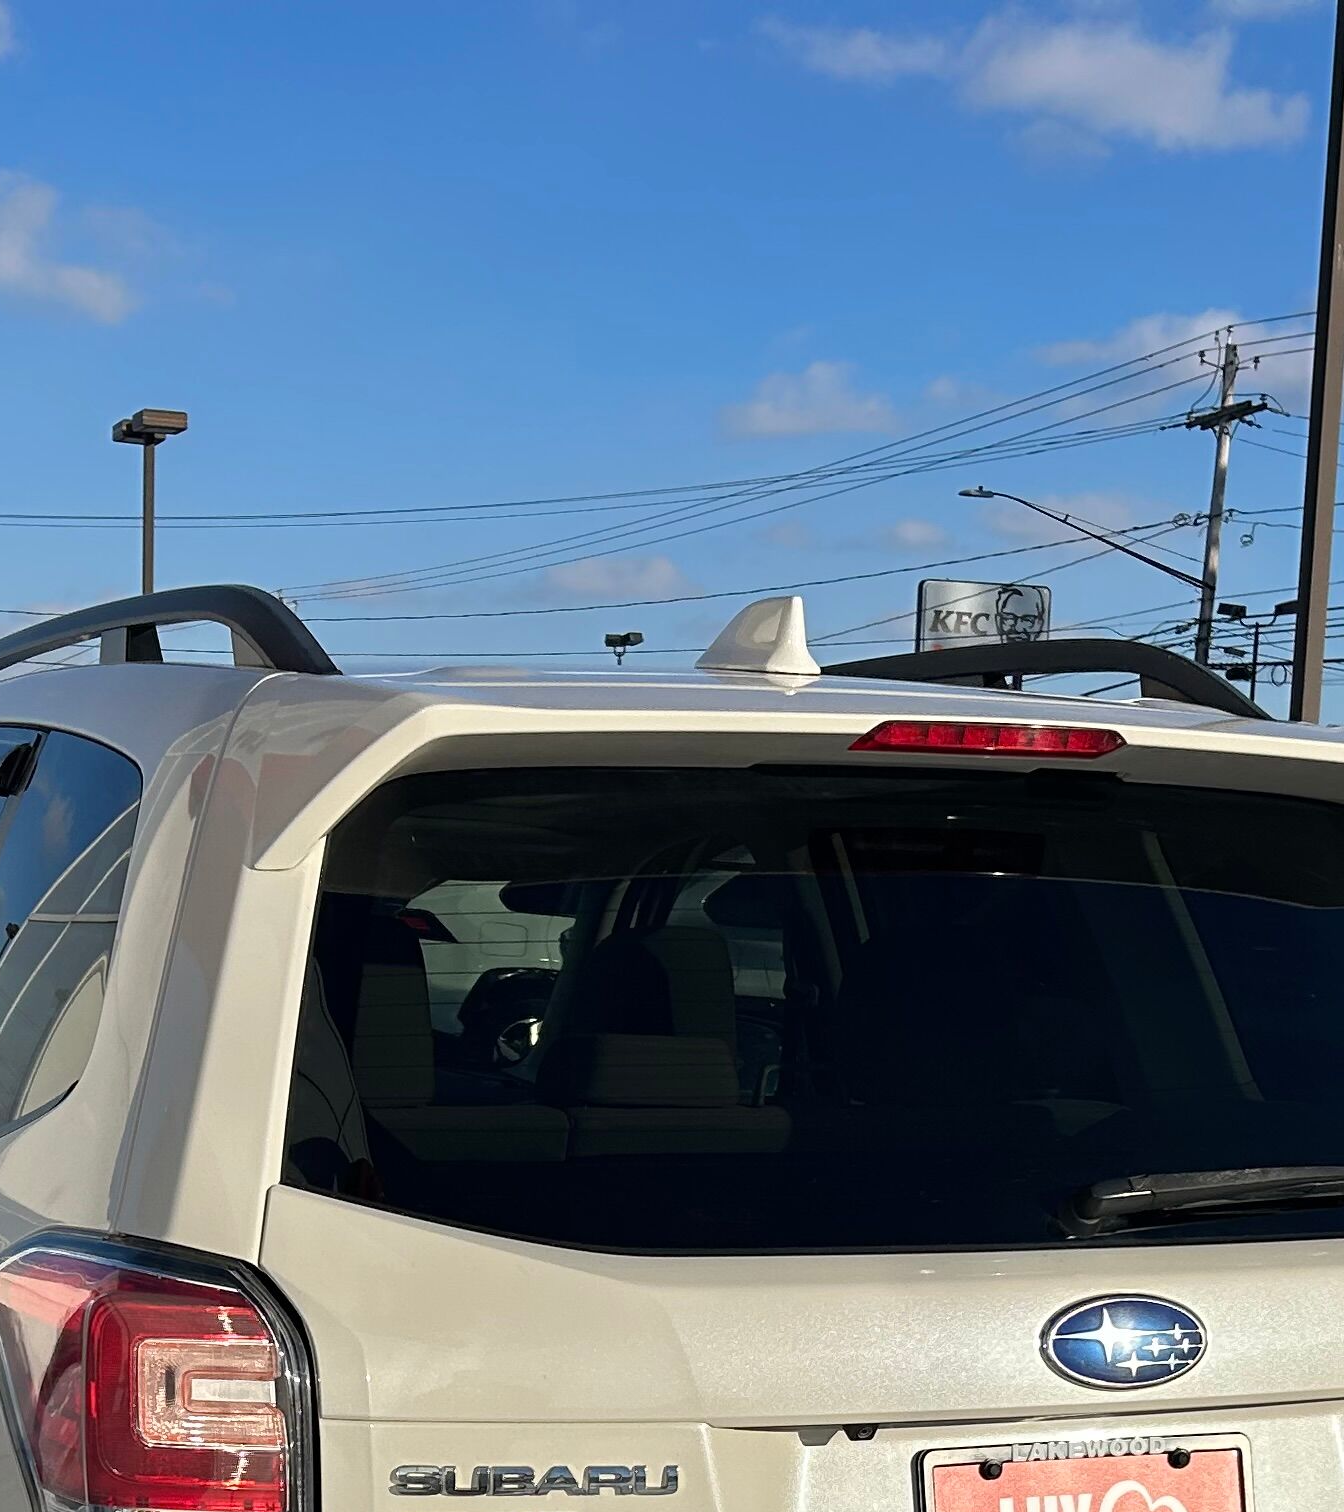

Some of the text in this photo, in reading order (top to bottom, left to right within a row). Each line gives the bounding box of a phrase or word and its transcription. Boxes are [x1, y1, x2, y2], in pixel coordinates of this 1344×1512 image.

[928, 609, 990, 635] KFC
[1010, 1436, 1167, 1463] LAKEWOOD
[388, 1464, 679, 1497] SUBARU
